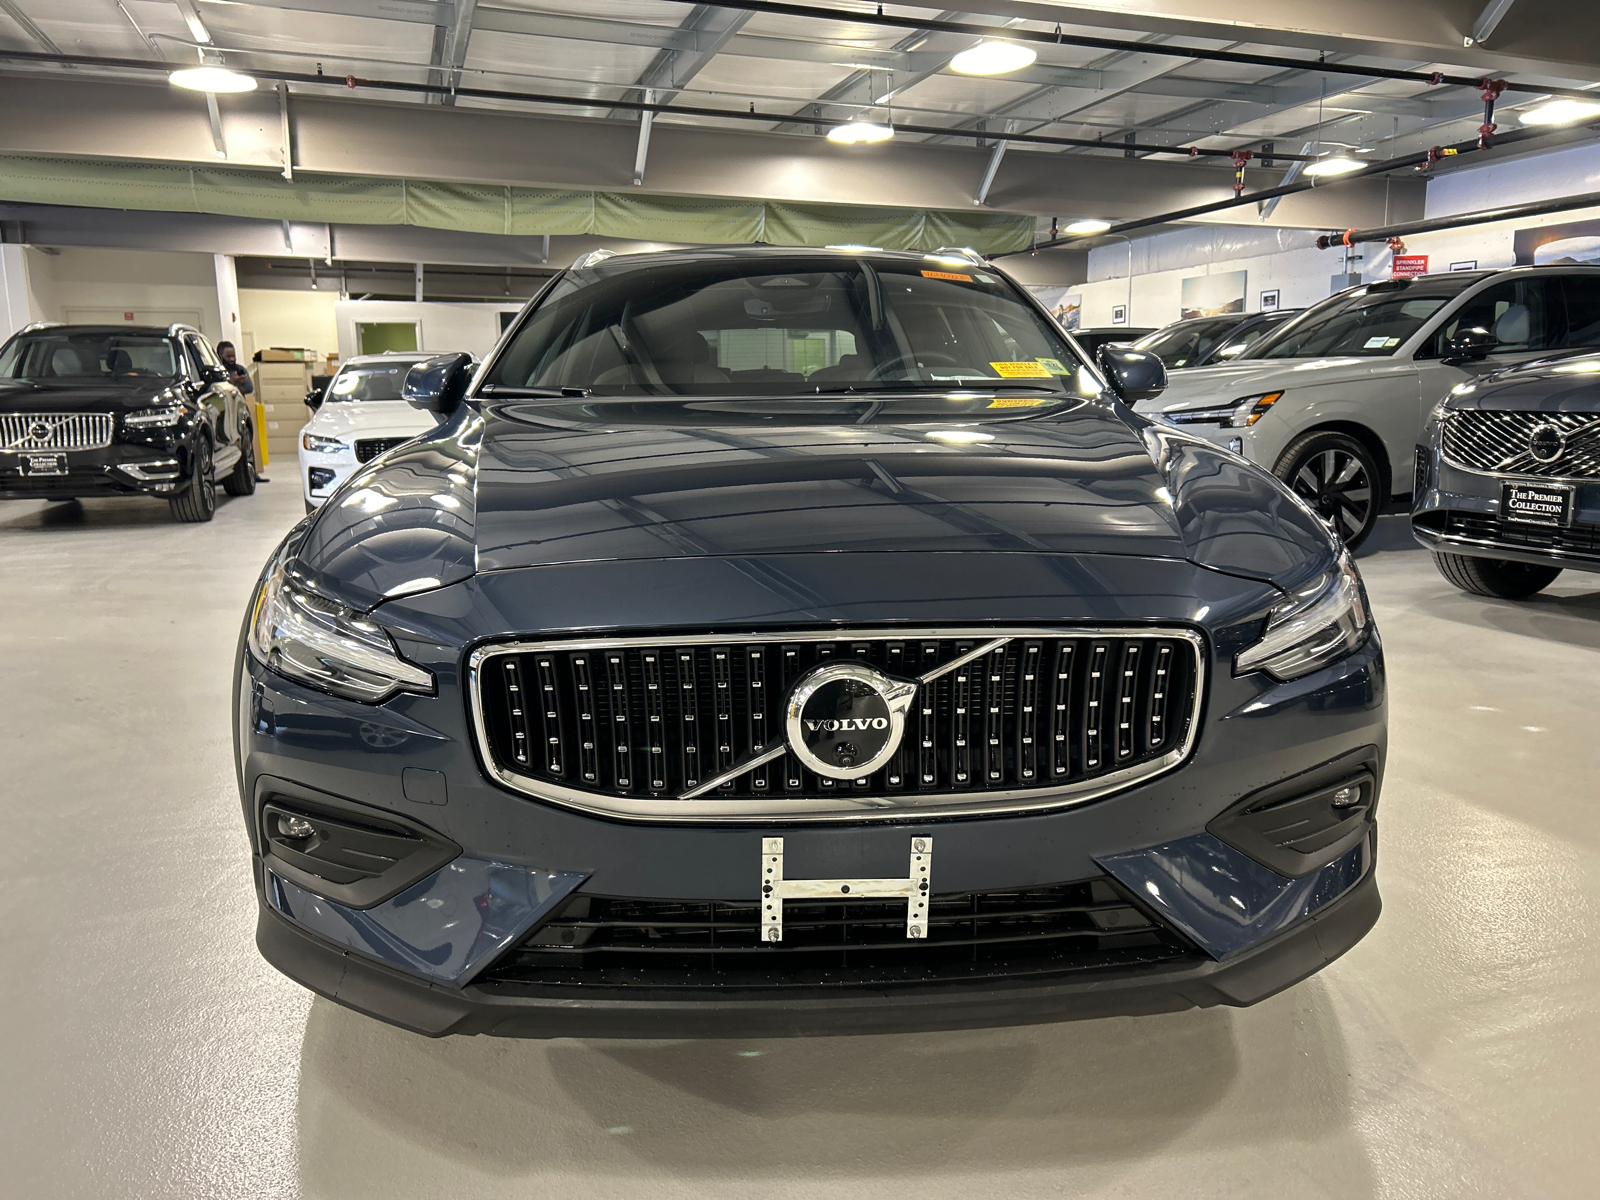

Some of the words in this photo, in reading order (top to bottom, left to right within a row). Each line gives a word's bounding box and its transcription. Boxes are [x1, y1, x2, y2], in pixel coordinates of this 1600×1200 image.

[1510, 489, 1527, 500] THE
[1528, 490, 1563, 503] PREMIER
[1508, 499, 1562, 513] COLLECTION
[804, 717, 888, 731] VOLVO
